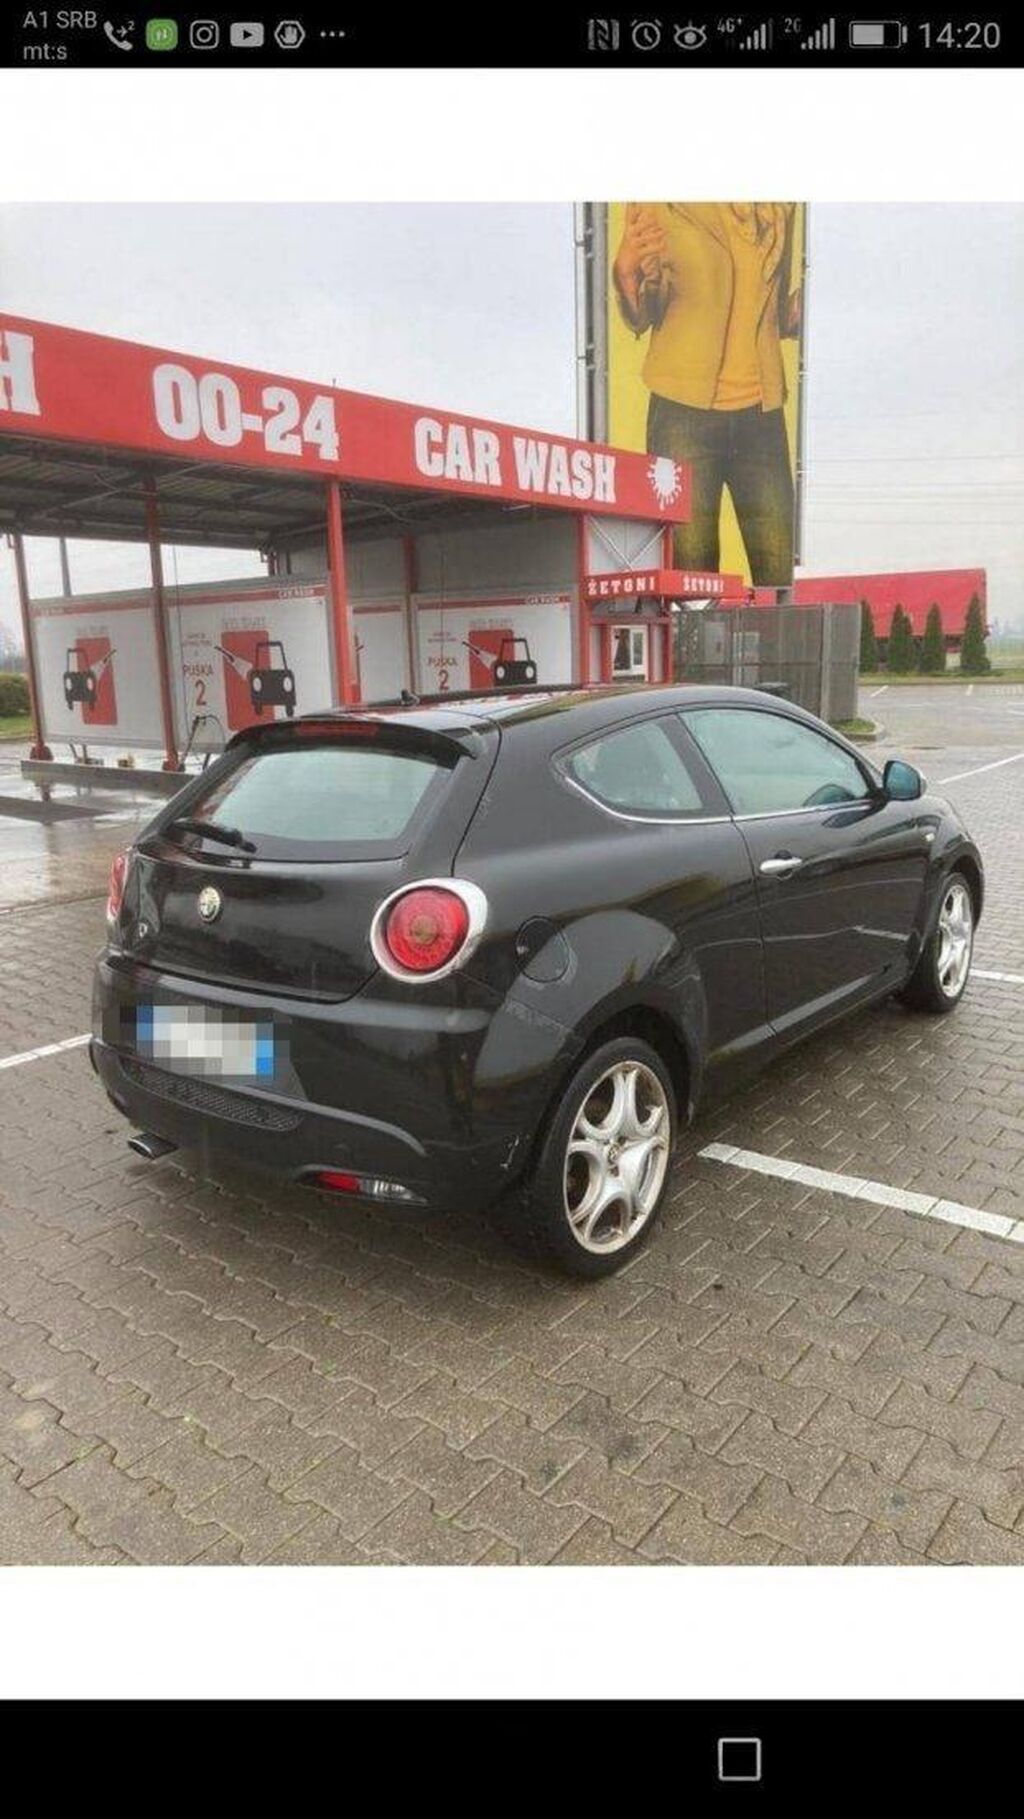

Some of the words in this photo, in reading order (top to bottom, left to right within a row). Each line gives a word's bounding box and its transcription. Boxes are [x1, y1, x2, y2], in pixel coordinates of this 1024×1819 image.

[152, 363, 339, 462] 00-24
[414, 417, 502, 487] CAR
[513, 437, 616, 503] WASH
[194, 680, 207, 706] 2
[438, 670, 449, 691] 2
